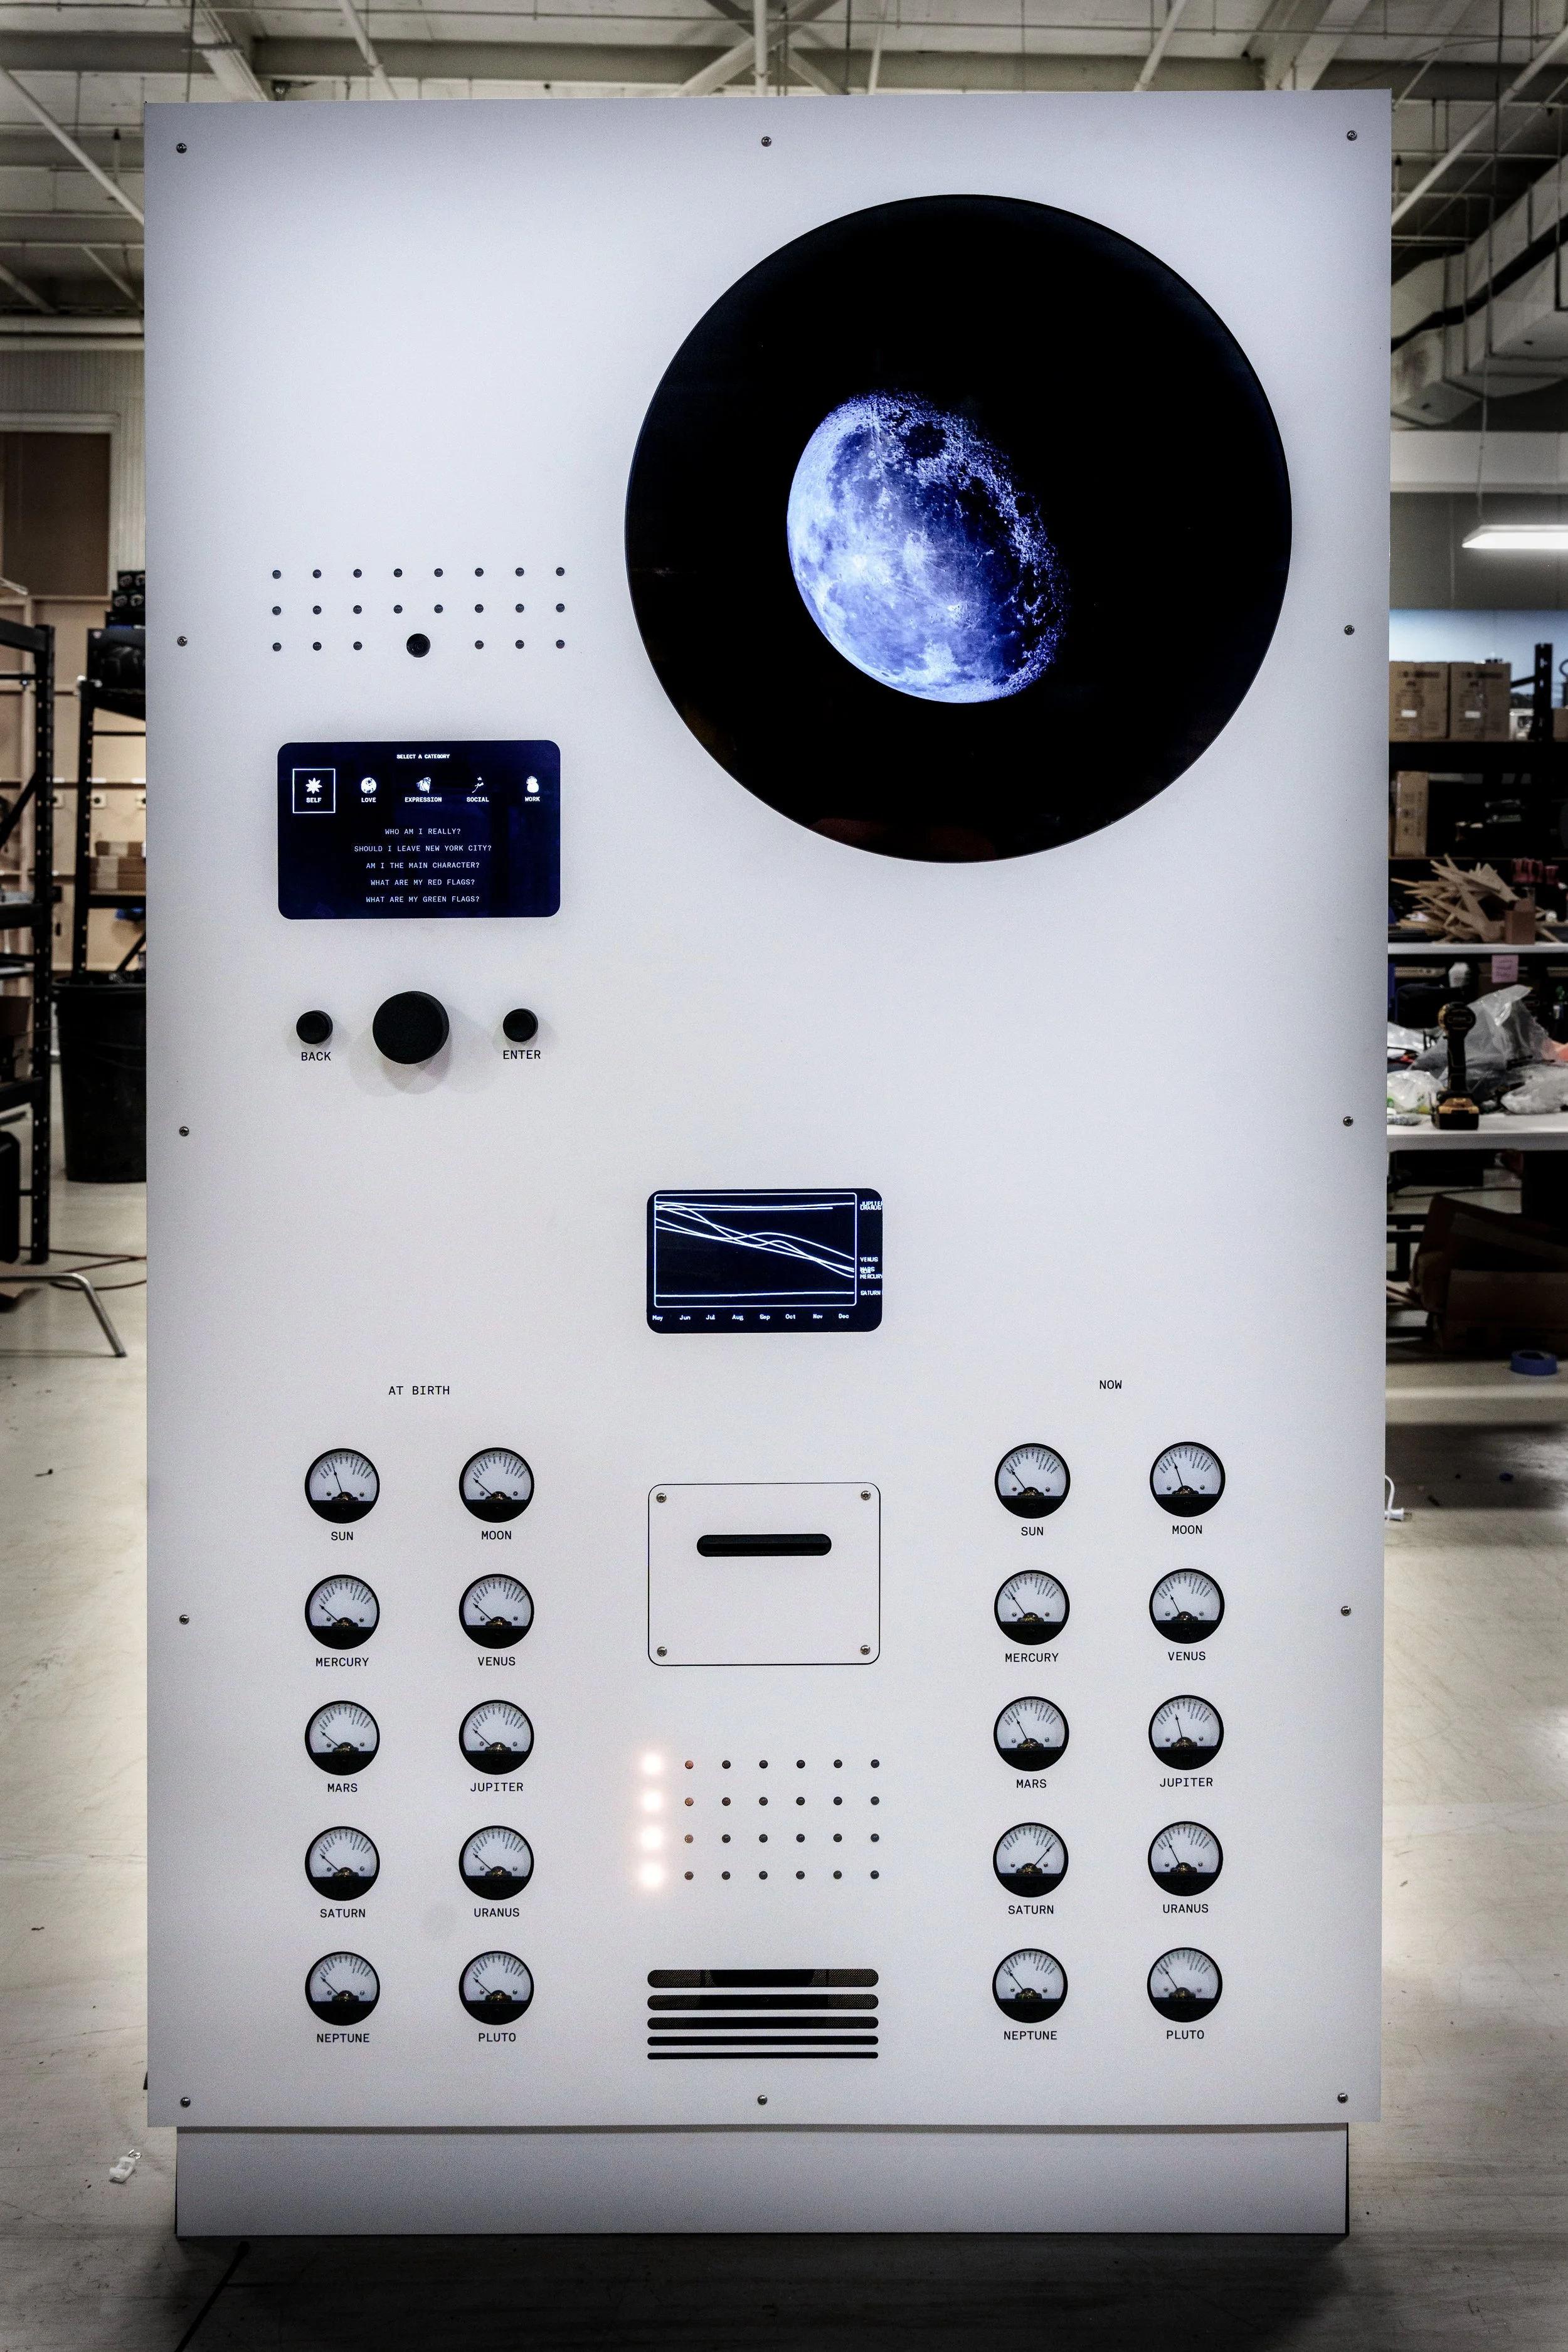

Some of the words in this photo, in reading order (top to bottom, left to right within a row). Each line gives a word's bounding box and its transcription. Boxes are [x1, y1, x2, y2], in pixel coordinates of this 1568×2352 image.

[301, 1051, 331, 1061] BACK
[503, 1049, 541, 1059] ENTER
[1099, 1380, 1122, 1389] NOW
[388, 1385, 404, 1396] AT
[412, 1385, 450, 1396] BIRTH
[481, 1530, 512, 1540] MOON
[1020, 1526, 1044, 1536] SUN
[1172, 1525, 1202, 1535] MOON
[331, 1531, 354, 1541] SUN
[477, 1656, 516, 1666] VENUS
[1005, 1653, 1059, 1663] MERCURY
[1168, 1651, 1206, 1661] VENUS
[315, 1657, 369, 1667] MERCURY
[470, 1782, 524, 1792] JUPITER
[1016, 1779, 1047, 1789] MARS
[1160, 1777, 1213, 1788] JUPITER
[327, 1783, 358, 1793] MARS
[320, 1909, 366, 1918] SATURN
[474, 1907, 520, 1917] URANUS
[1008, 1905, 1054, 1915] SATURN
[1163, 1904, 1209, 1914] URANUS
[316, 2033, 370, 2043] NEPTUNE
[478, 2032, 516, 2042] PLUTO
[1004, 2030, 1057, 2040] NEPTUNE
[1167, 2030, 1204, 2040] PLUTO
